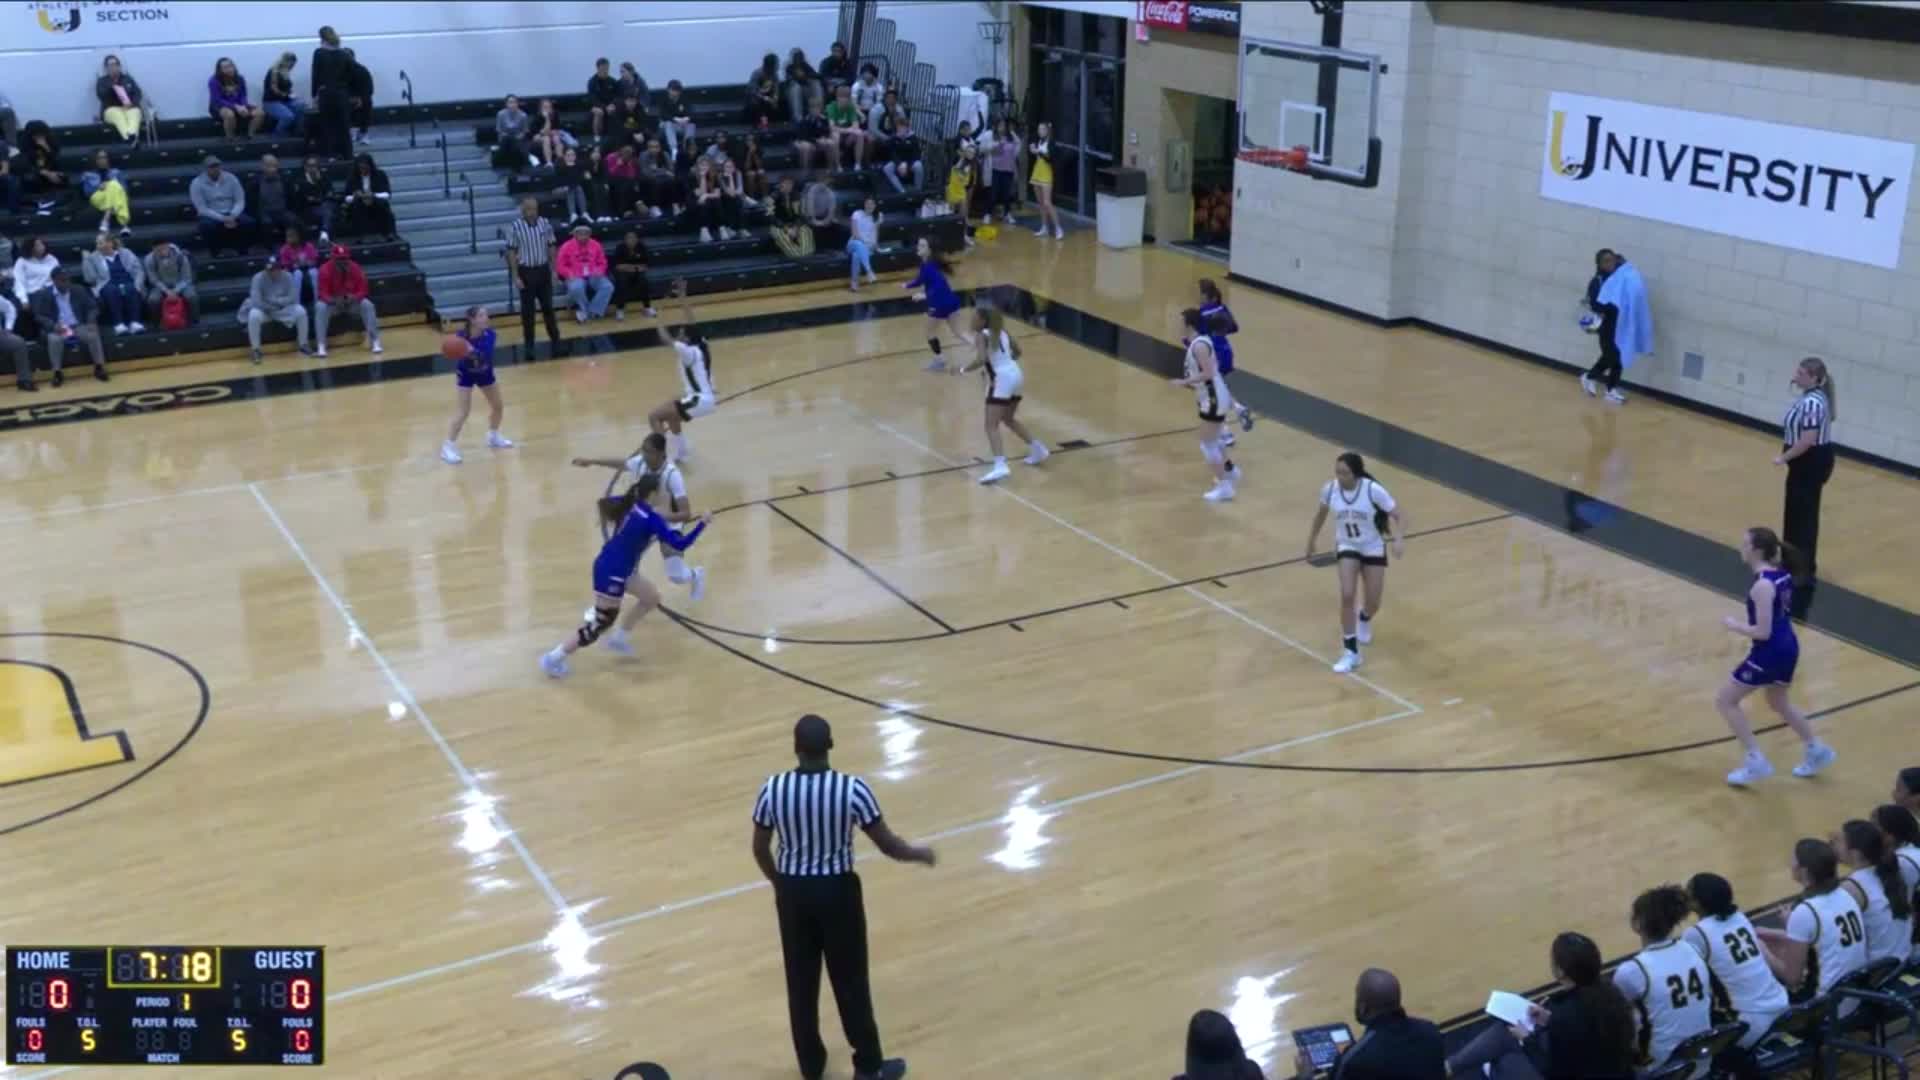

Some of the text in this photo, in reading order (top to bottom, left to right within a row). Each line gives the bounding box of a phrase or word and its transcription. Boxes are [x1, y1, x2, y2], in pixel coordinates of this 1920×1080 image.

[96, 9, 169, 22] SECTION
[1550, 110, 1896, 219] UNIVERSITY
[1344, 522, 1361, 538] 11
[1723, 927, 1760, 964] 23
[1835, 911, 1862, 948] 30
[1666, 967, 1705, 1009] 24
